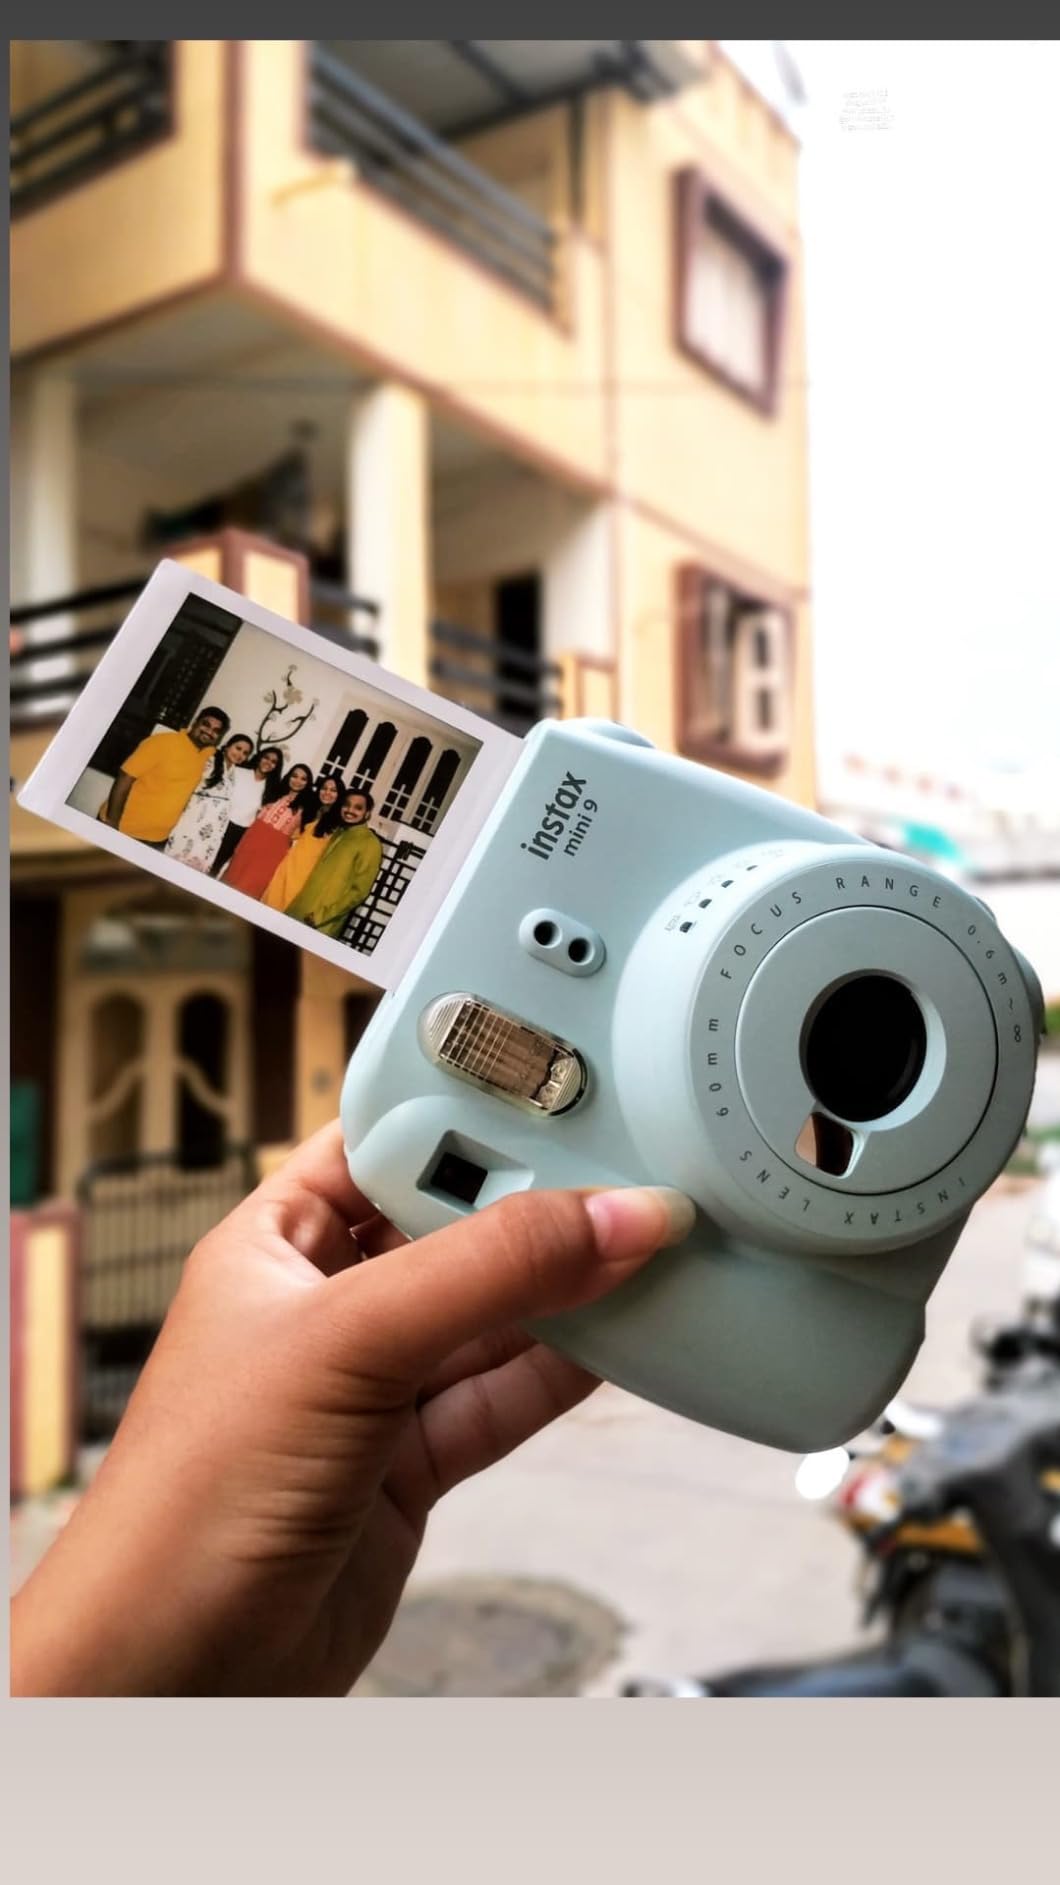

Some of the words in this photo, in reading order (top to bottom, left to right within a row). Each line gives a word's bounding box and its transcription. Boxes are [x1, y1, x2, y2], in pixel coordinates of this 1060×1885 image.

[520, 771, 587, 860] instax
[563, 812, 593, 857] mini
[584, 798, 599, 814] 9
[835, 875, 942, 908] RANGE
[720, 891, 803, 980] FOCUS
[739, 1149, 811, 1213] LENS
[843, 1176, 966, 1225] INSTAX
